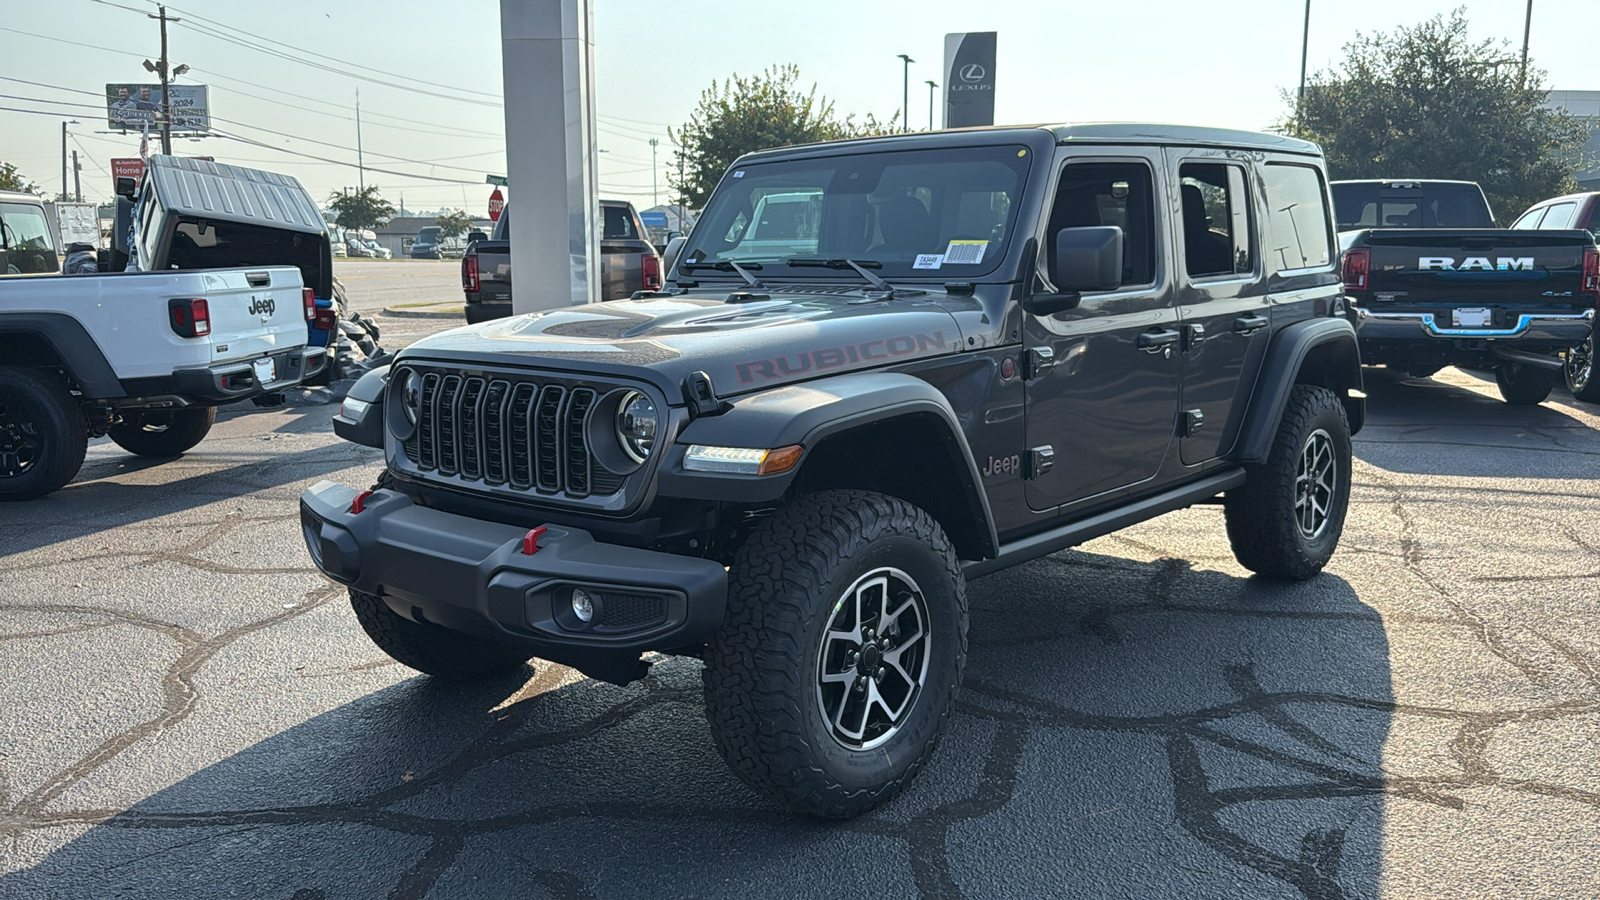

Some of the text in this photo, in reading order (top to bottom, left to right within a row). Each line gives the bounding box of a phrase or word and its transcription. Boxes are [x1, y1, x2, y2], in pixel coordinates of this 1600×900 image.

[173, 98, 194, 107] 2024
[116, 166, 140, 174] Home
[490, 199, 503, 213] STOP
[1418, 256, 1535, 271] RAM
[248, 295, 275, 316] Jeep
[735, 331, 947, 384] RUBICON
[982, 454, 1020, 477] Jeep
